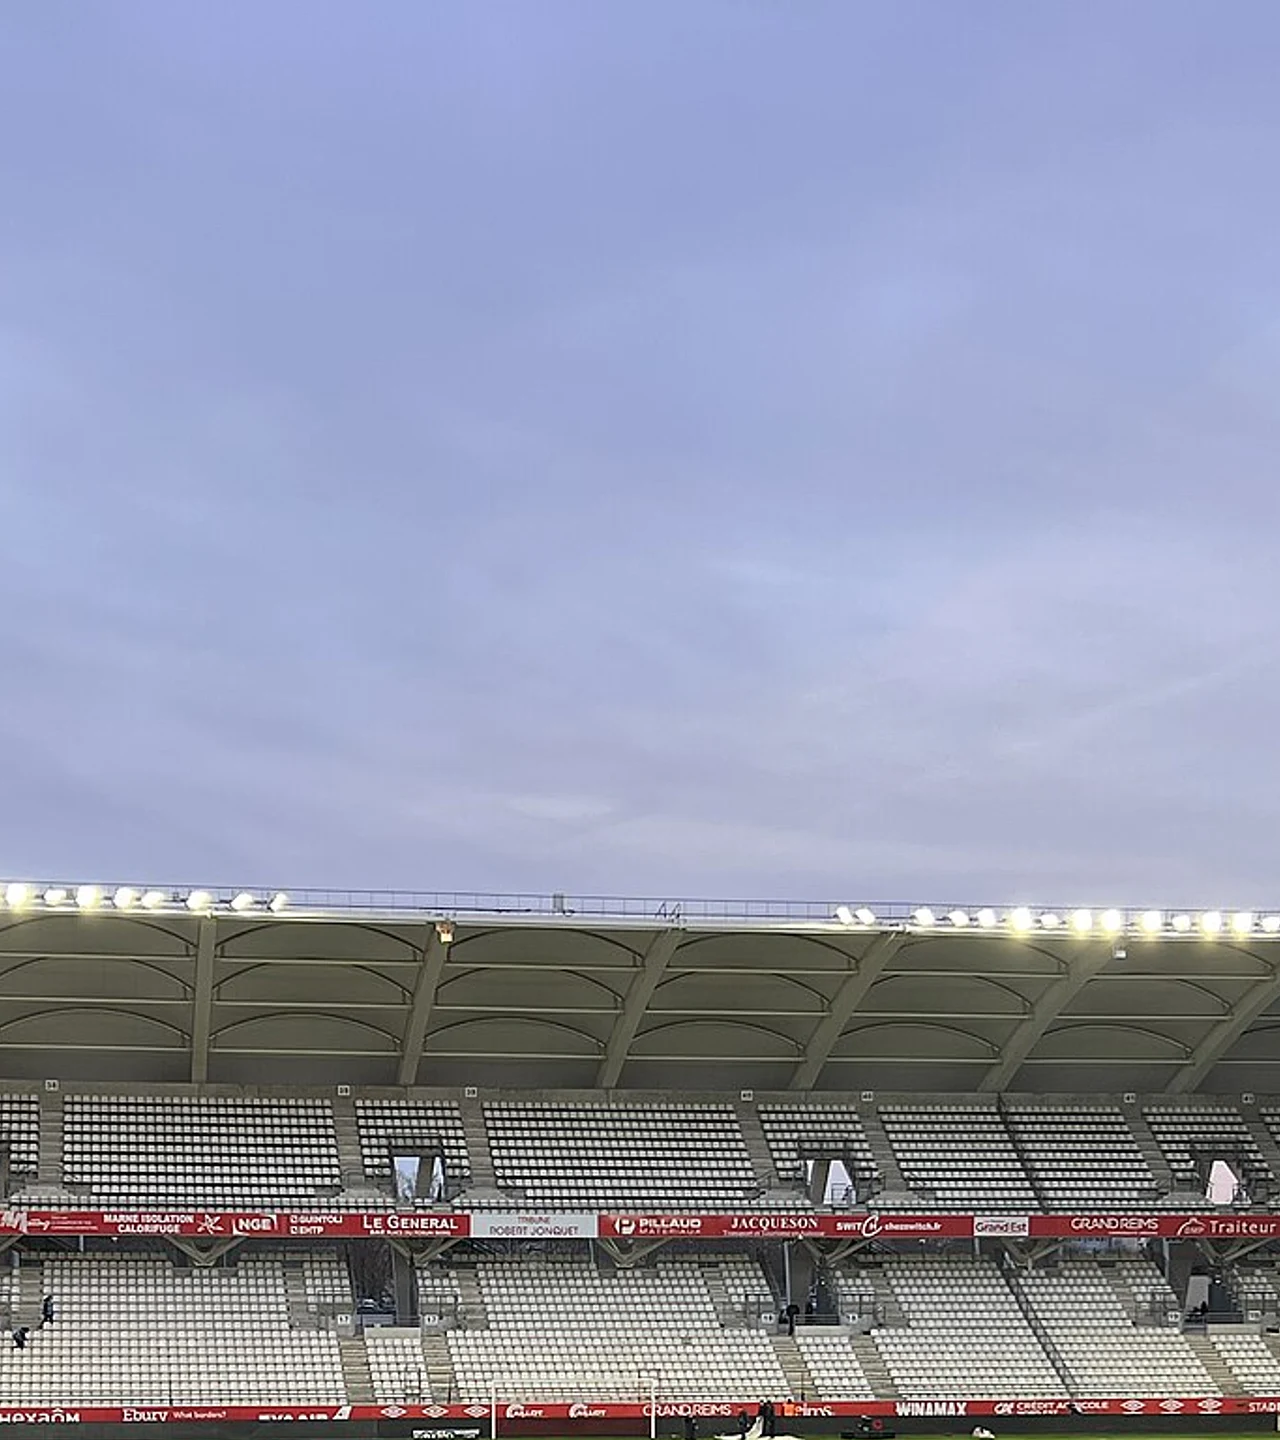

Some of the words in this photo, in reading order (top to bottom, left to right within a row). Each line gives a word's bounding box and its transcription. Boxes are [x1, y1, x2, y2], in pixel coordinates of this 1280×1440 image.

[103, 1214, 139, 1223] MARNE
[140, 1214, 194, 1224] ISOLATION
[238, 1218, 272, 1231] NGE
[639, 1218, 701, 1228] PILLAUD
[731, 1217, 819, 1230] JACQUESON
[1071, 1218, 1118, 1230] GRAND
[1118, 1218, 1159, 1230] REIMS
[117, 1223, 181, 1233] CALORIFUGE
[489, 1226, 529, 1236] ROBERT
[530, 1226, 579, 1236] JONQUET
[976, 1221, 1009, 1234] Grand
[1011, 1222, 1027, 1233] Est
[1209, 1220, 1277, 1234] Traiteur
[693, 1404, 732, 1416] REIMS
[895, 1402, 968, 1416] WINAMAX
